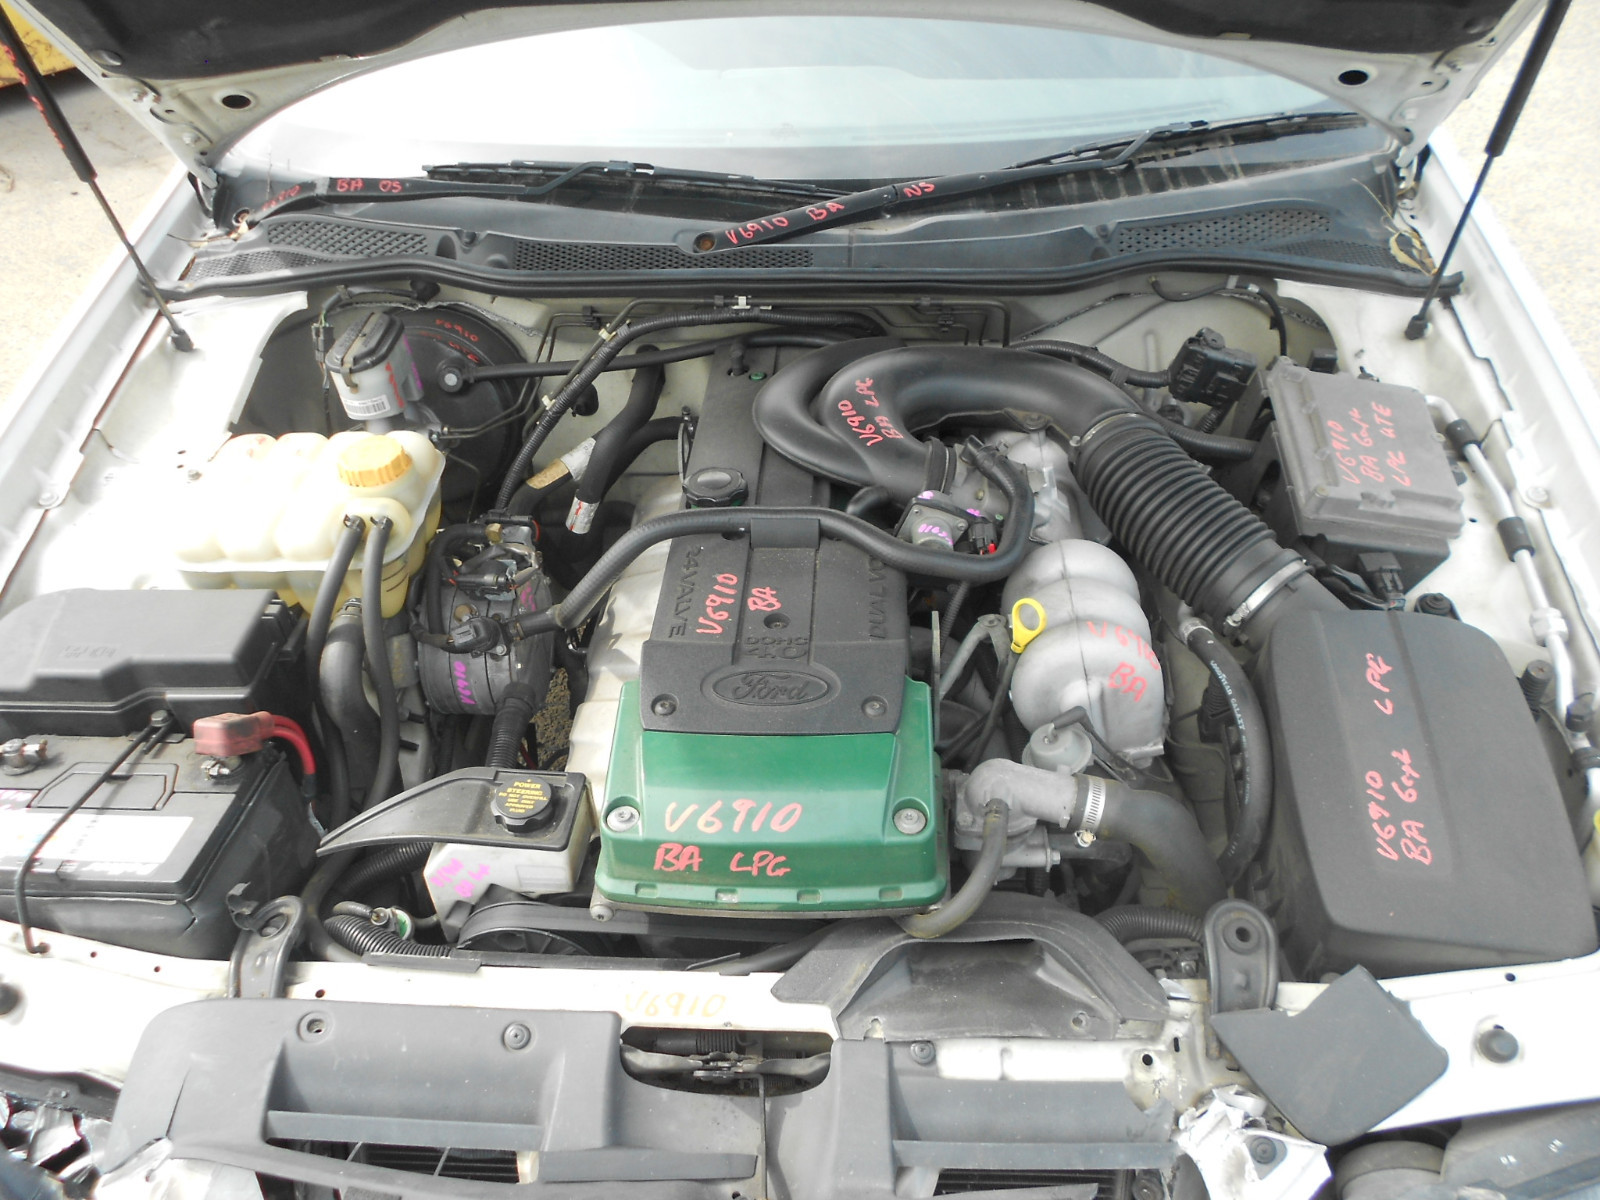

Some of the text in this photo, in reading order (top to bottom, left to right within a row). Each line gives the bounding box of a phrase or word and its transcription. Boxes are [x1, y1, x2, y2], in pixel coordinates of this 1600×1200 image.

[724, 181, 936, 245] V6910 BA NS
[838, 400, 884, 447] V6910
[1327, 419, 1361, 484] V6910
[1359, 454, 1386, 482] BA
[696, 572, 738, 635] V6910
[747, 586, 782, 612] BA
[732, 674, 812, 701] Ford
[1107, 661, 1149, 703] BA
[1230, 697, 1247, 731] GALAXY
[506, 787, 544, 796] STEERING
[665, 798, 803, 834] V6910
[1365, 770, 1399, 862] V6910
[653, 842, 792, 877] BA LPG
[1400, 819, 1432, 866] BA
